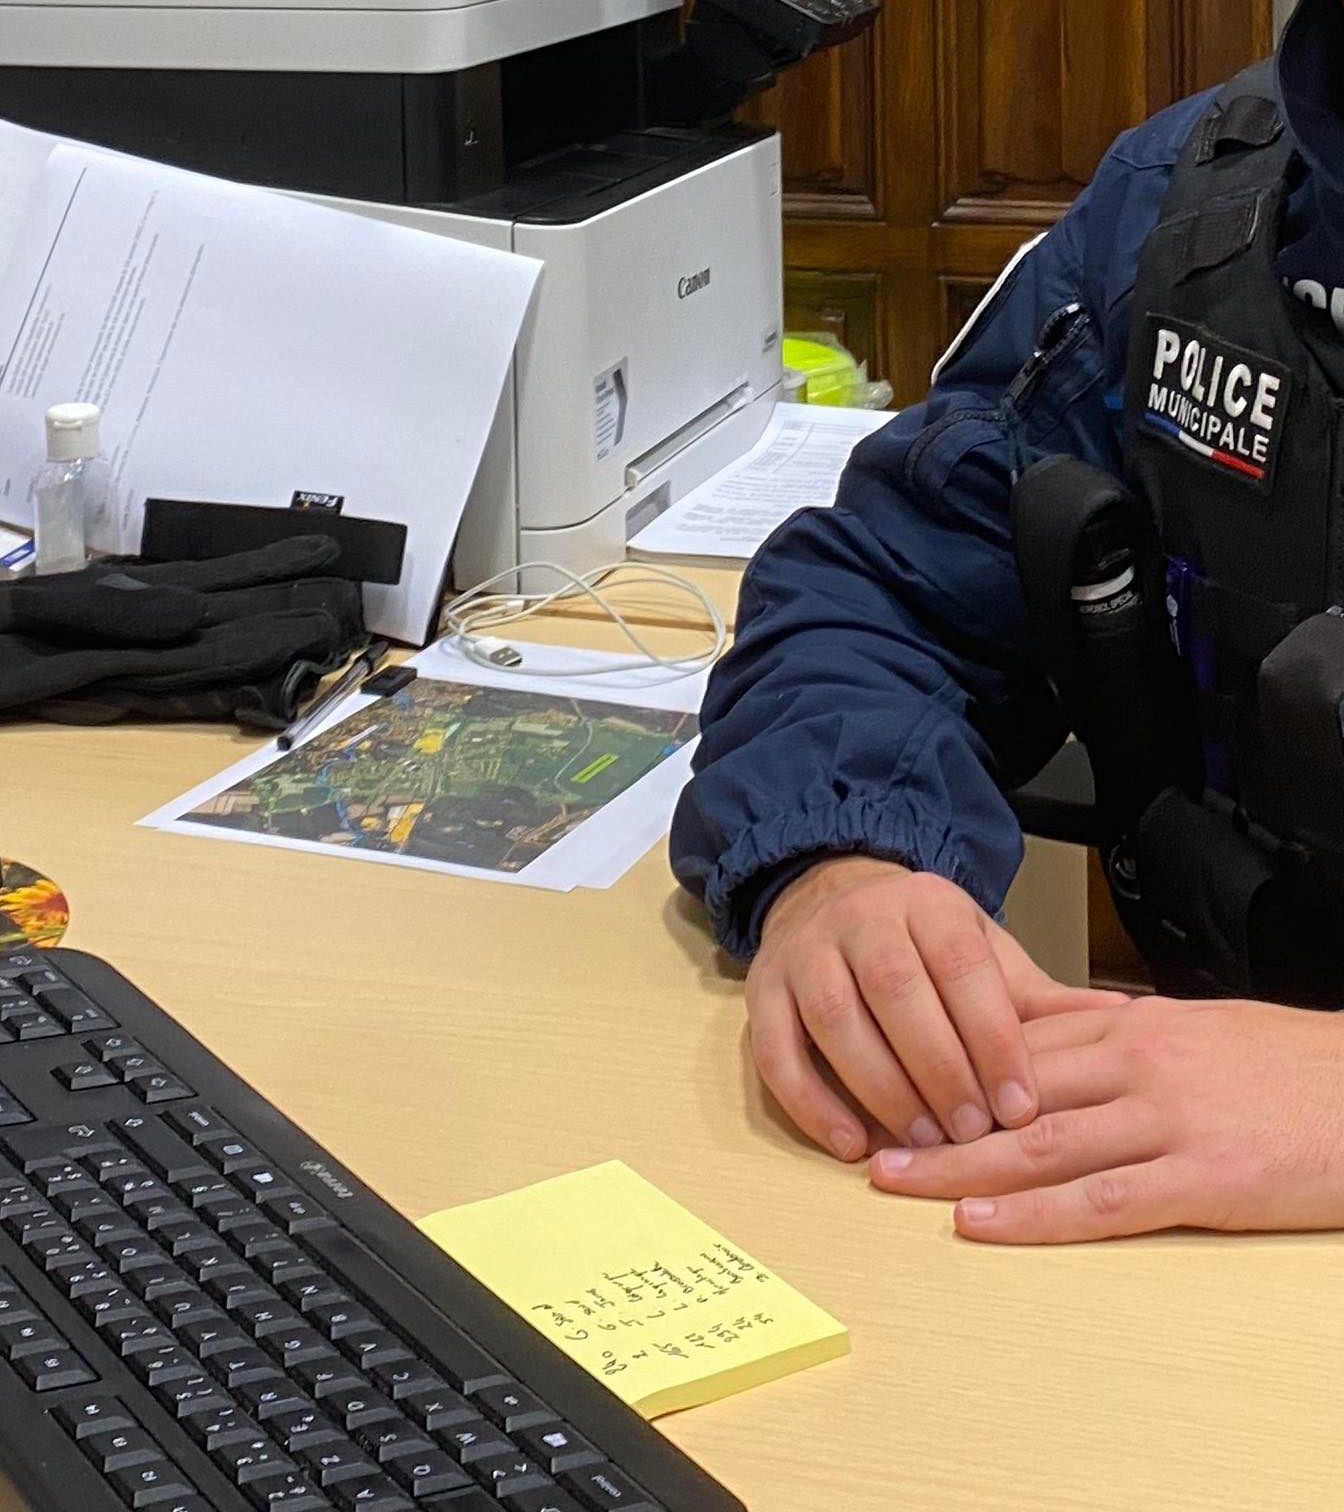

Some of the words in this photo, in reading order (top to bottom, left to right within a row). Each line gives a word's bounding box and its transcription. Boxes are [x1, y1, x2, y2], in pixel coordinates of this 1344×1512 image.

[677, 267, 711, 300] Canon
[1153, 328, 1281, 431] POLICE
[1146, 382, 1270, 463] MUNICIPALE
